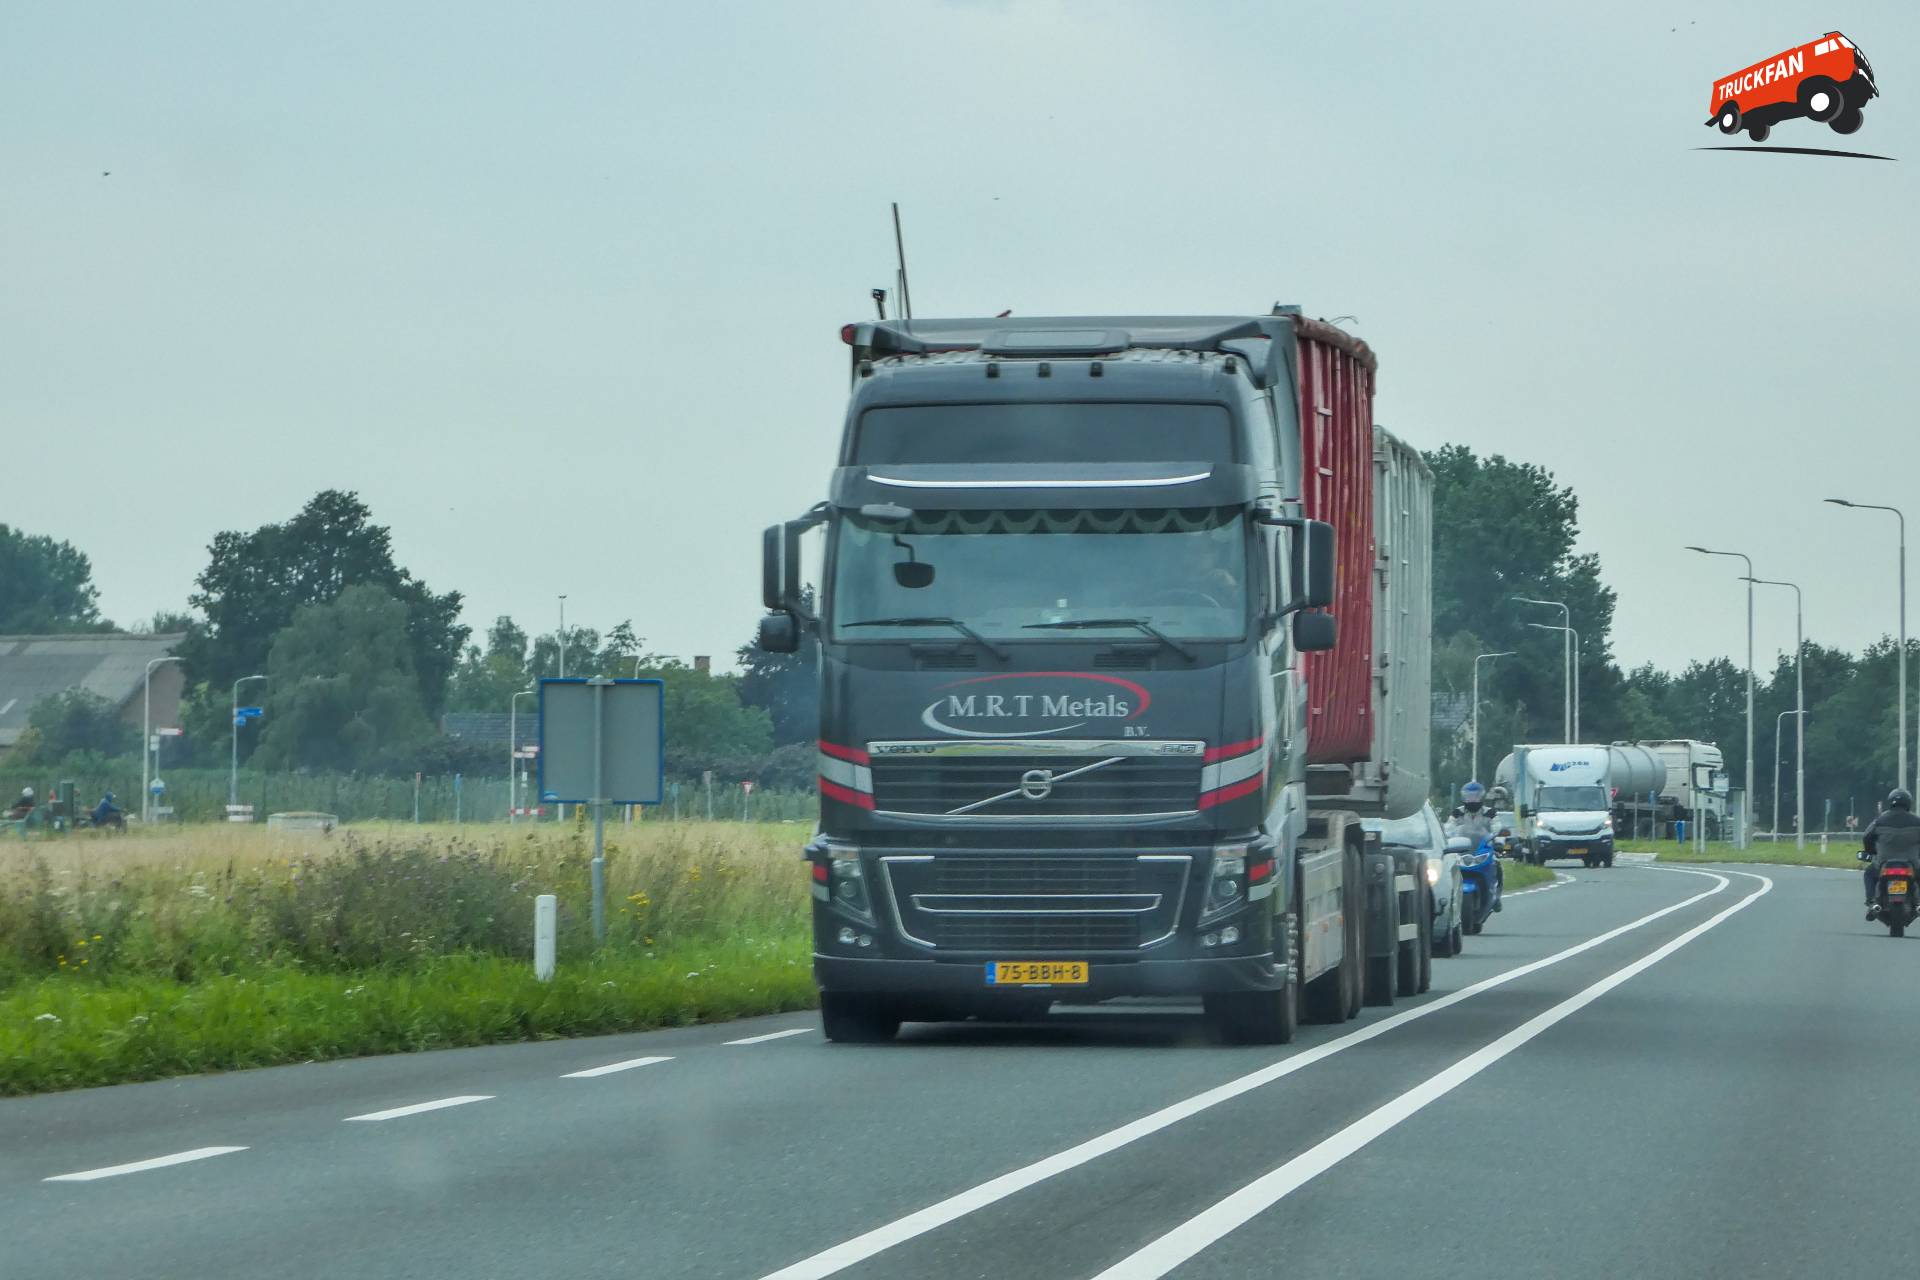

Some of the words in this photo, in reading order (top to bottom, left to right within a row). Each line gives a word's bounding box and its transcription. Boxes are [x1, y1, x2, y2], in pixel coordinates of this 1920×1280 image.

[949, 695, 1034, 717] M.R.T
[1041, 694, 1129, 717] Metals
[1124, 726, 1150, 737] B.V.
[875, 744, 936, 754] VOLVO
[1000, 964, 1081, 980] 75-BBH-8
